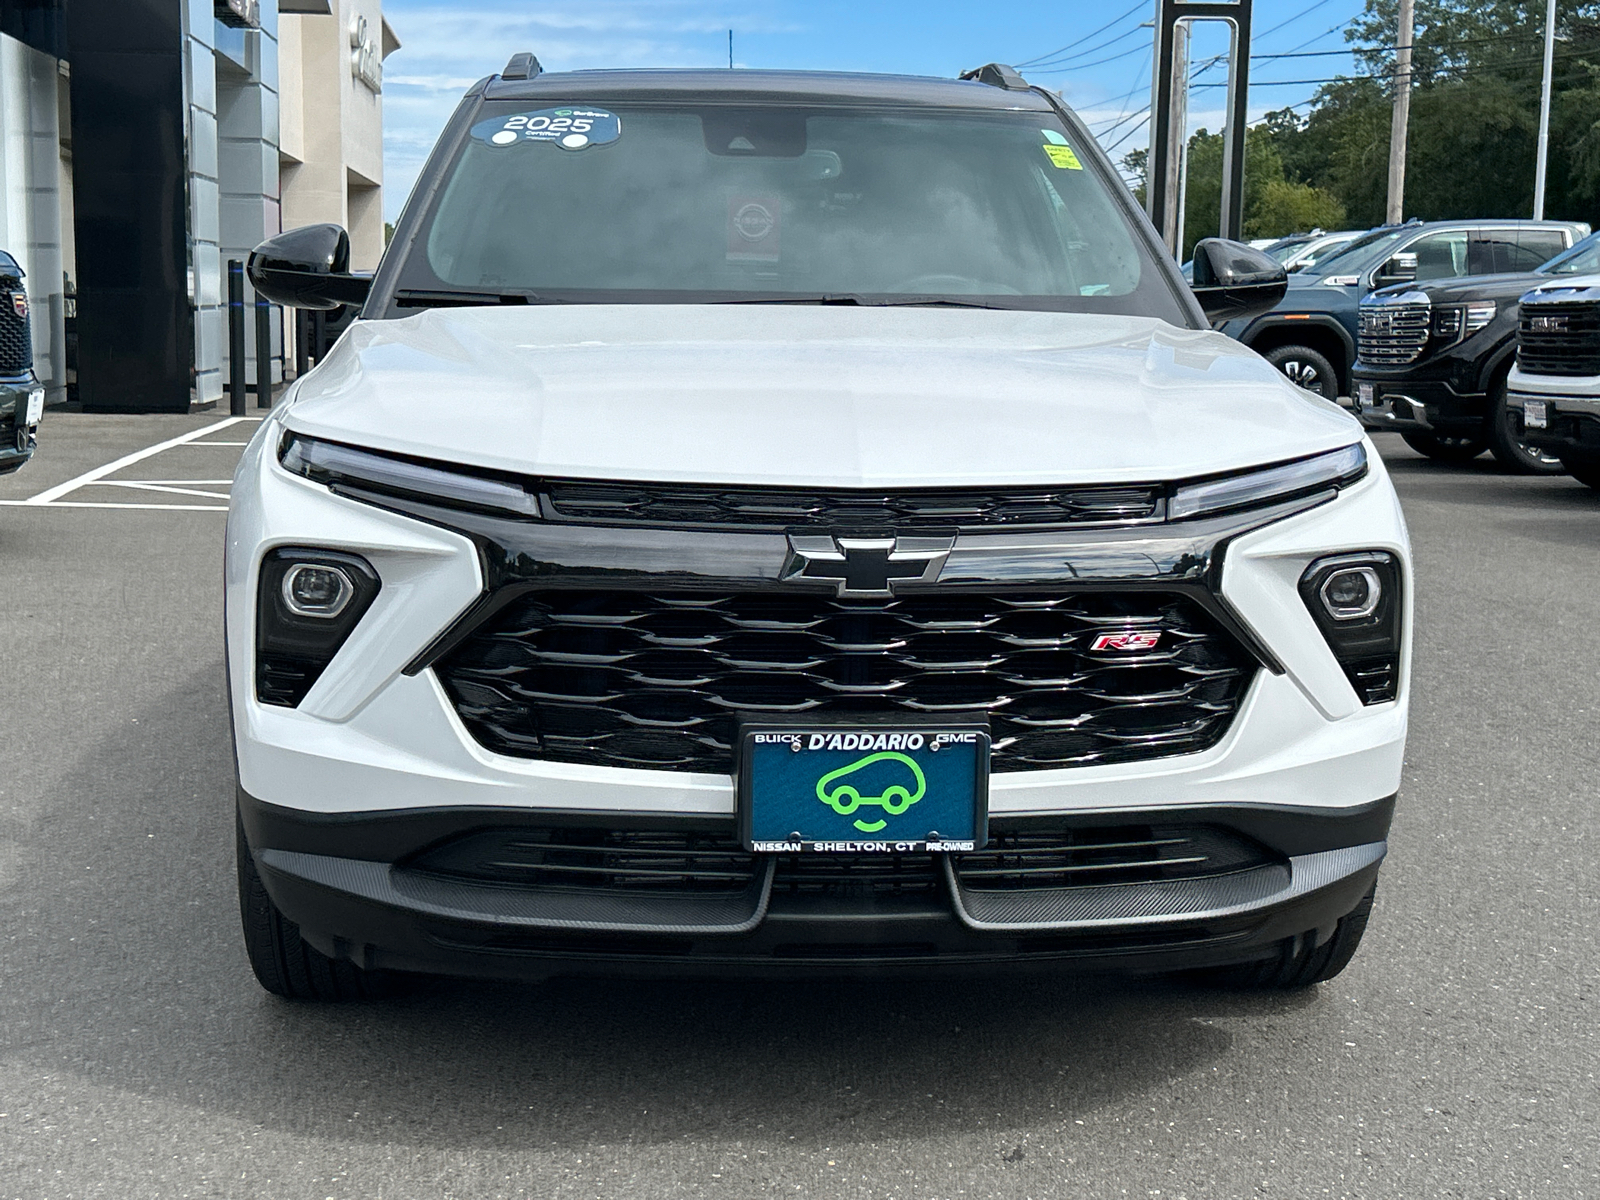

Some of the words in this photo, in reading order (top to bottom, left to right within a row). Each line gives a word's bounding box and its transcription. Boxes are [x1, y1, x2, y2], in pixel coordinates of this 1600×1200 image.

[503, 116, 594, 133] 2025
[1531, 316, 1569, 333] GMC
[1090, 632, 1162, 651] RS
[754, 734, 802, 744] BUICK
[808, 733, 924, 751] D'ADDARIO
[936, 733, 977, 743] GMC
[753, 842, 802, 852] NISSAN
[813, 842, 891, 853] SHELTON,
[895, 842, 916, 852] CT
[926, 842, 974, 852] PRE-OWNED
